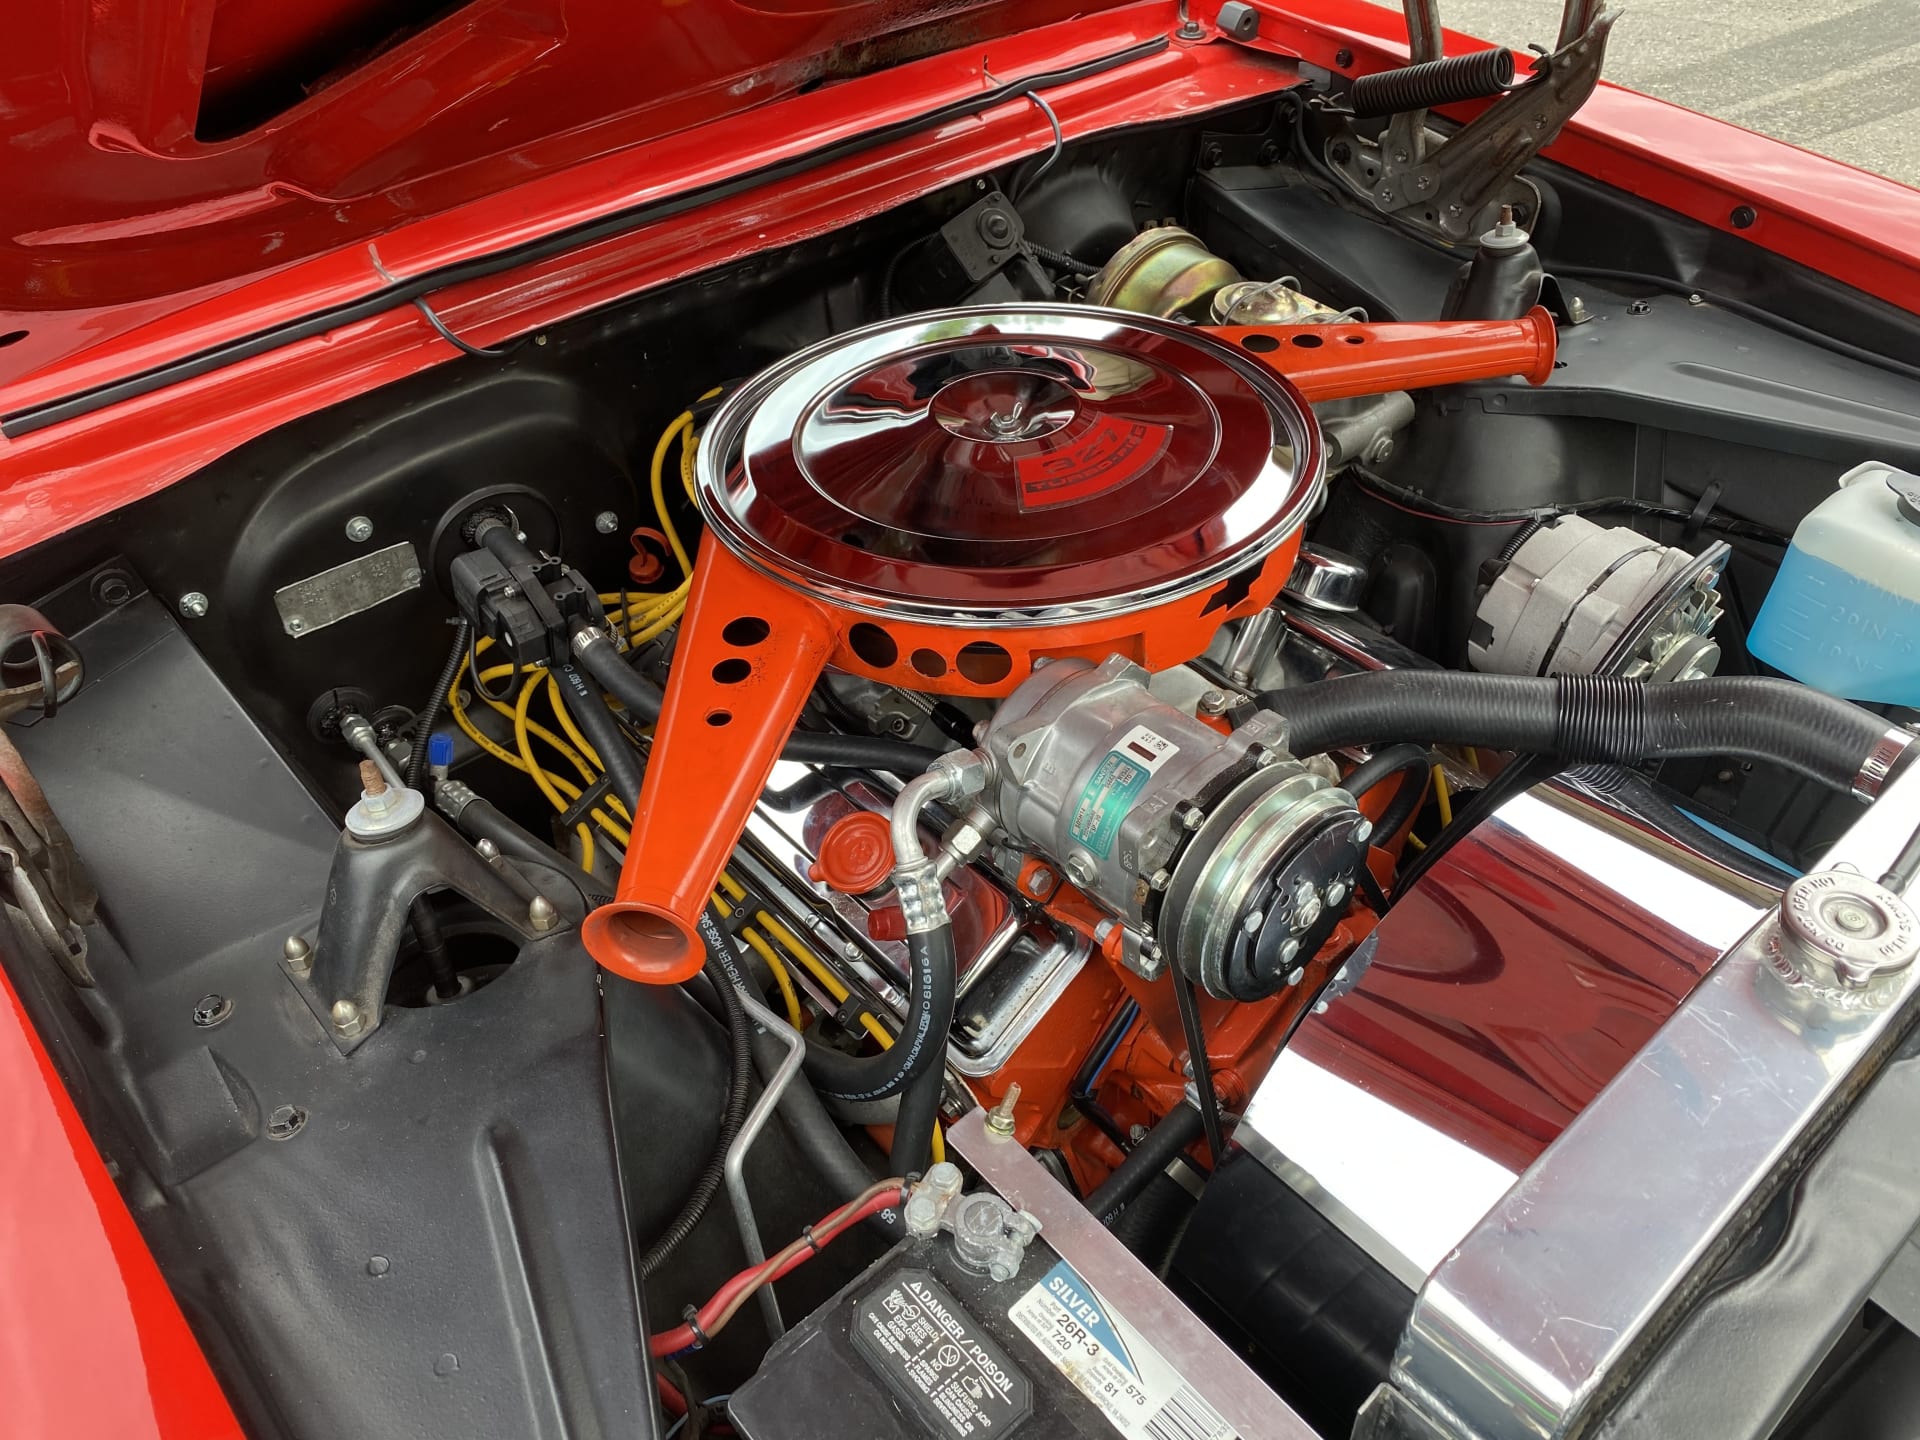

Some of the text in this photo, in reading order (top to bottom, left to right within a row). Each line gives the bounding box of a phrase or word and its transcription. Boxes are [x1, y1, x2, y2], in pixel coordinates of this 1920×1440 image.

[1042, 428, 1120, 474] 327
[706, 928, 723, 948] HOSE
[717, 951, 741, 981] HEATER
[1049, 1275, 1099, 1327] SILVER
[886, 1321, 905, 1340] GASES
[892, 1315, 922, 1346] EXPLOSIVE
[911, 1323, 926, 1339] EYES
[917, 1317, 938, 1338] SHIELD
[1057, 1313, 1098, 1356] 26R-3
[920, 1291, 963, 1337] DANGER
[970, 1346, 1012, 1391] POISON
[1051, 1329, 1071, 1350] 720
[930, 1359, 941, 1371] NO
[1103, 1382, 1118, 1397] 81
[1125, 1384, 1146, 1405] 575
[944, 1388, 972, 1418] CAN CAUSE
[949, 1382, 991, 1427] SULFURIC ACID
[963, 1421, 974, 1432] OR
